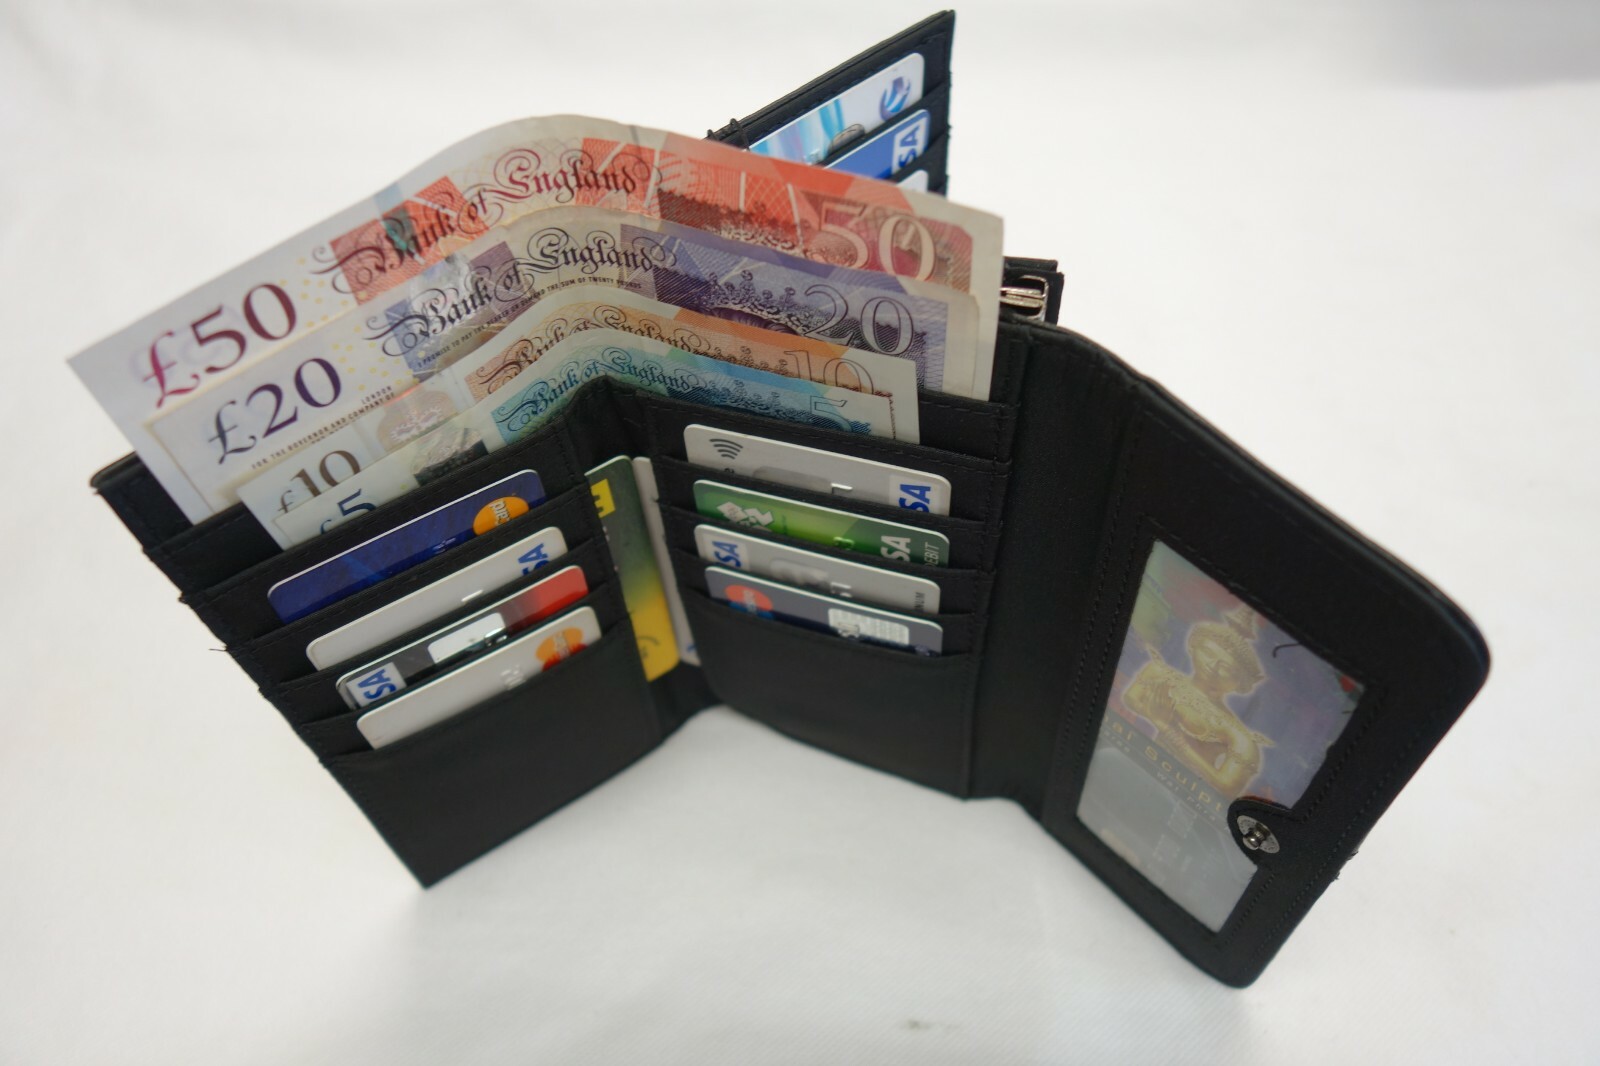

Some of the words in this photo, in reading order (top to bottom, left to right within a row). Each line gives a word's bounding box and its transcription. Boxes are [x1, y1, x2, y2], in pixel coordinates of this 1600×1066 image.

[899, 125, 920, 167] SA
[312, 191, 457, 294] Bank
[490, 148, 662, 203] England
[806, 202, 936, 281] 50
[364, 264, 492, 357] Bank
[494, 258, 536, 303] of
[524, 226, 677, 276] England
[423, 346, 451, 365] PROMISE
[452, 340, 461, 348] TO
[461, 333, 473, 343] PAY
[547, 284, 560, 293] THE
[561, 280, 576, 288] SUM
[804, 284, 913, 355] 20
[142, 283, 297, 408] £50
[784, 350, 874, 394] 10
[207, 357, 342, 464] £20
[361, 385, 393, 405] LONDON
[496, 360, 580, 431] Bank
[600, 346, 708, 393] England
[809, 395, 854, 433] 5
[251, 458, 268, 470] FOR
[270, 449, 286, 460] THE
[331, 417, 347, 428] AND
[348, 399, 384, 420] COMPANY
[383, 392, 396, 404] OF
[899, 484, 931, 513] SA
[517, 543, 549, 575] SA
[712, 541, 742, 567] SA
[881, 535, 911, 563] SA
[357, 668, 397, 700] SA
[1144, 745, 1222, 811] Sculpt
